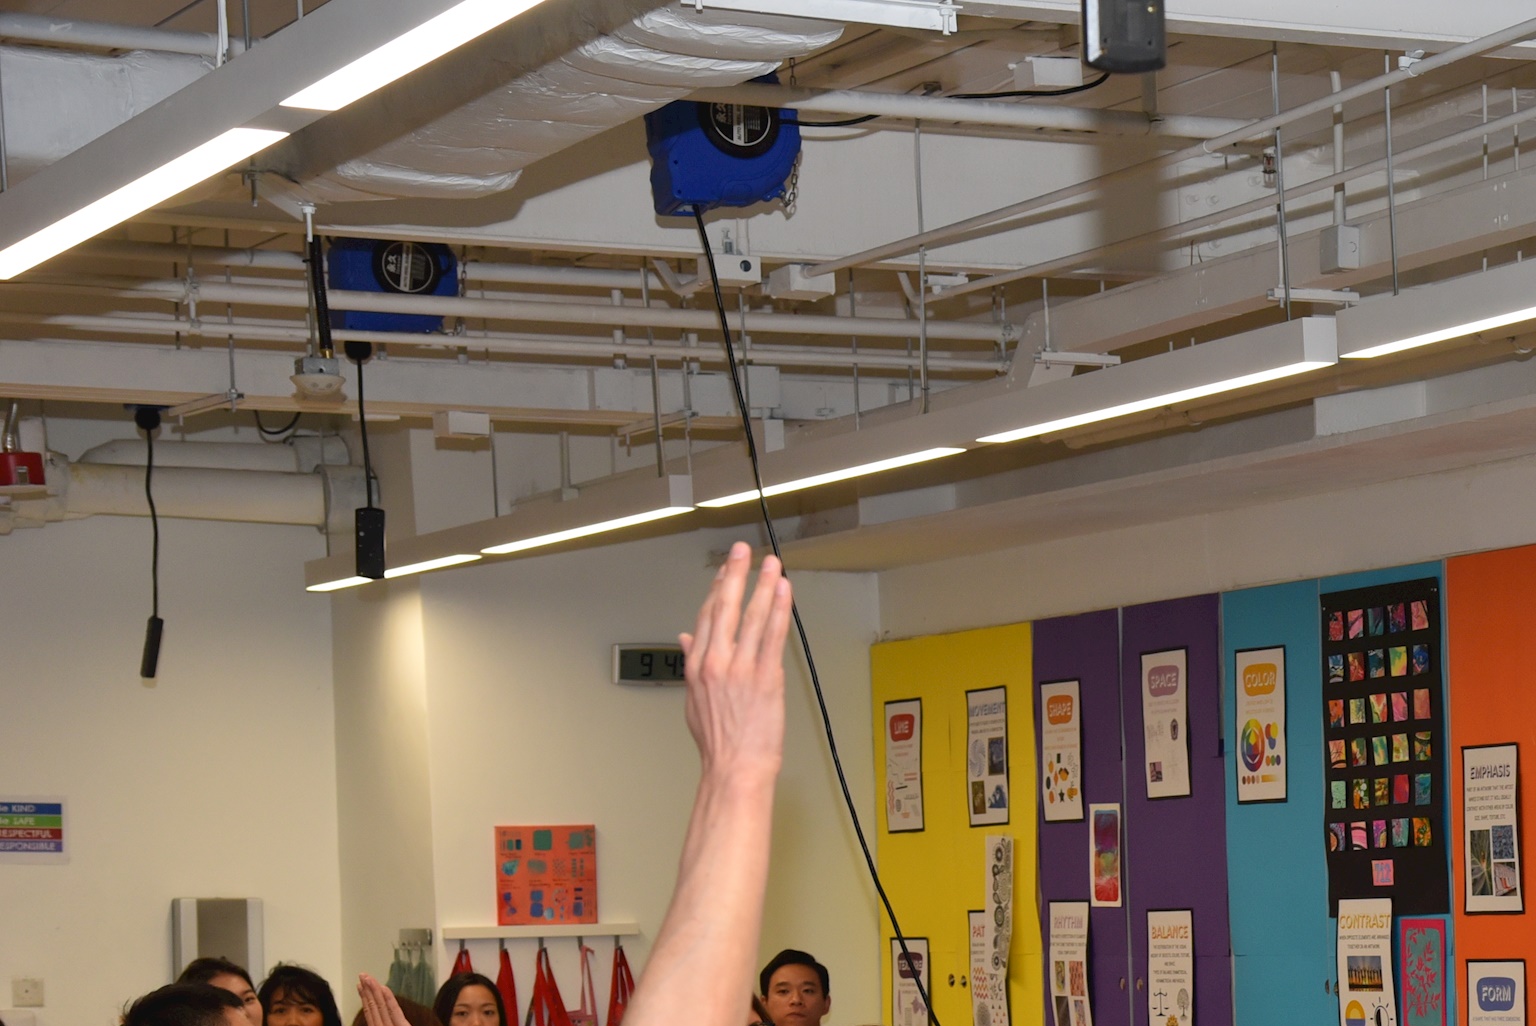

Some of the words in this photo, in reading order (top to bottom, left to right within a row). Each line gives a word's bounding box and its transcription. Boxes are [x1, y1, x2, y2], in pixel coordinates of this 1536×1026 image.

[1151, 673, 1176, 689] SPACE
[1245, 672, 1275, 688] COLOR
[1048, 702, 1072, 717] SHAPE
[1471, 765, 1510, 779] EMPHASIS
[1340, 914, 1390, 929] CONTRAST
[1152, 926, 1188, 939] BALANCE
[1482, 985, 1511, 1001] FORM
